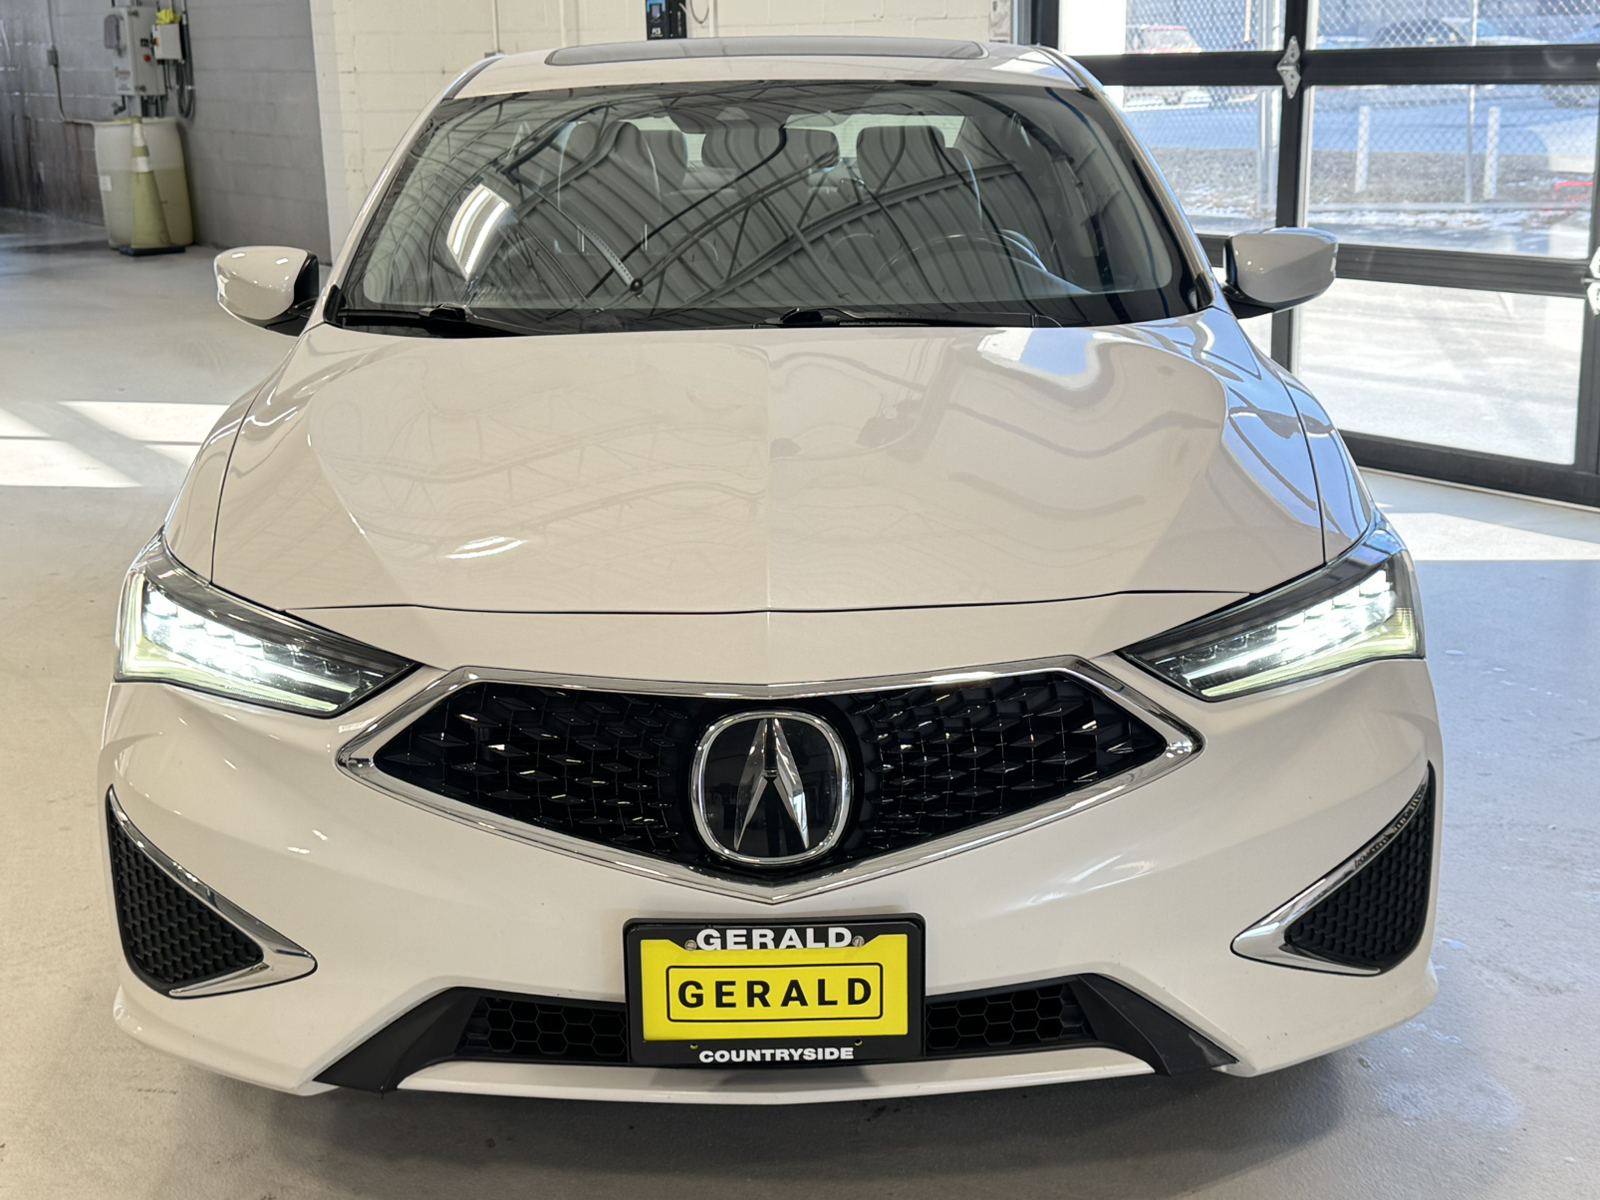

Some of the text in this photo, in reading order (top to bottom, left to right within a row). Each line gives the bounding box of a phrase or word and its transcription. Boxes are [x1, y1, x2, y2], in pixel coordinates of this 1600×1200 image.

[696, 927, 852, 951] GERALD
[678, 977, 872, 1009] GERALD
[698, 1047, 854, 1063] COUNTRYSIDE
